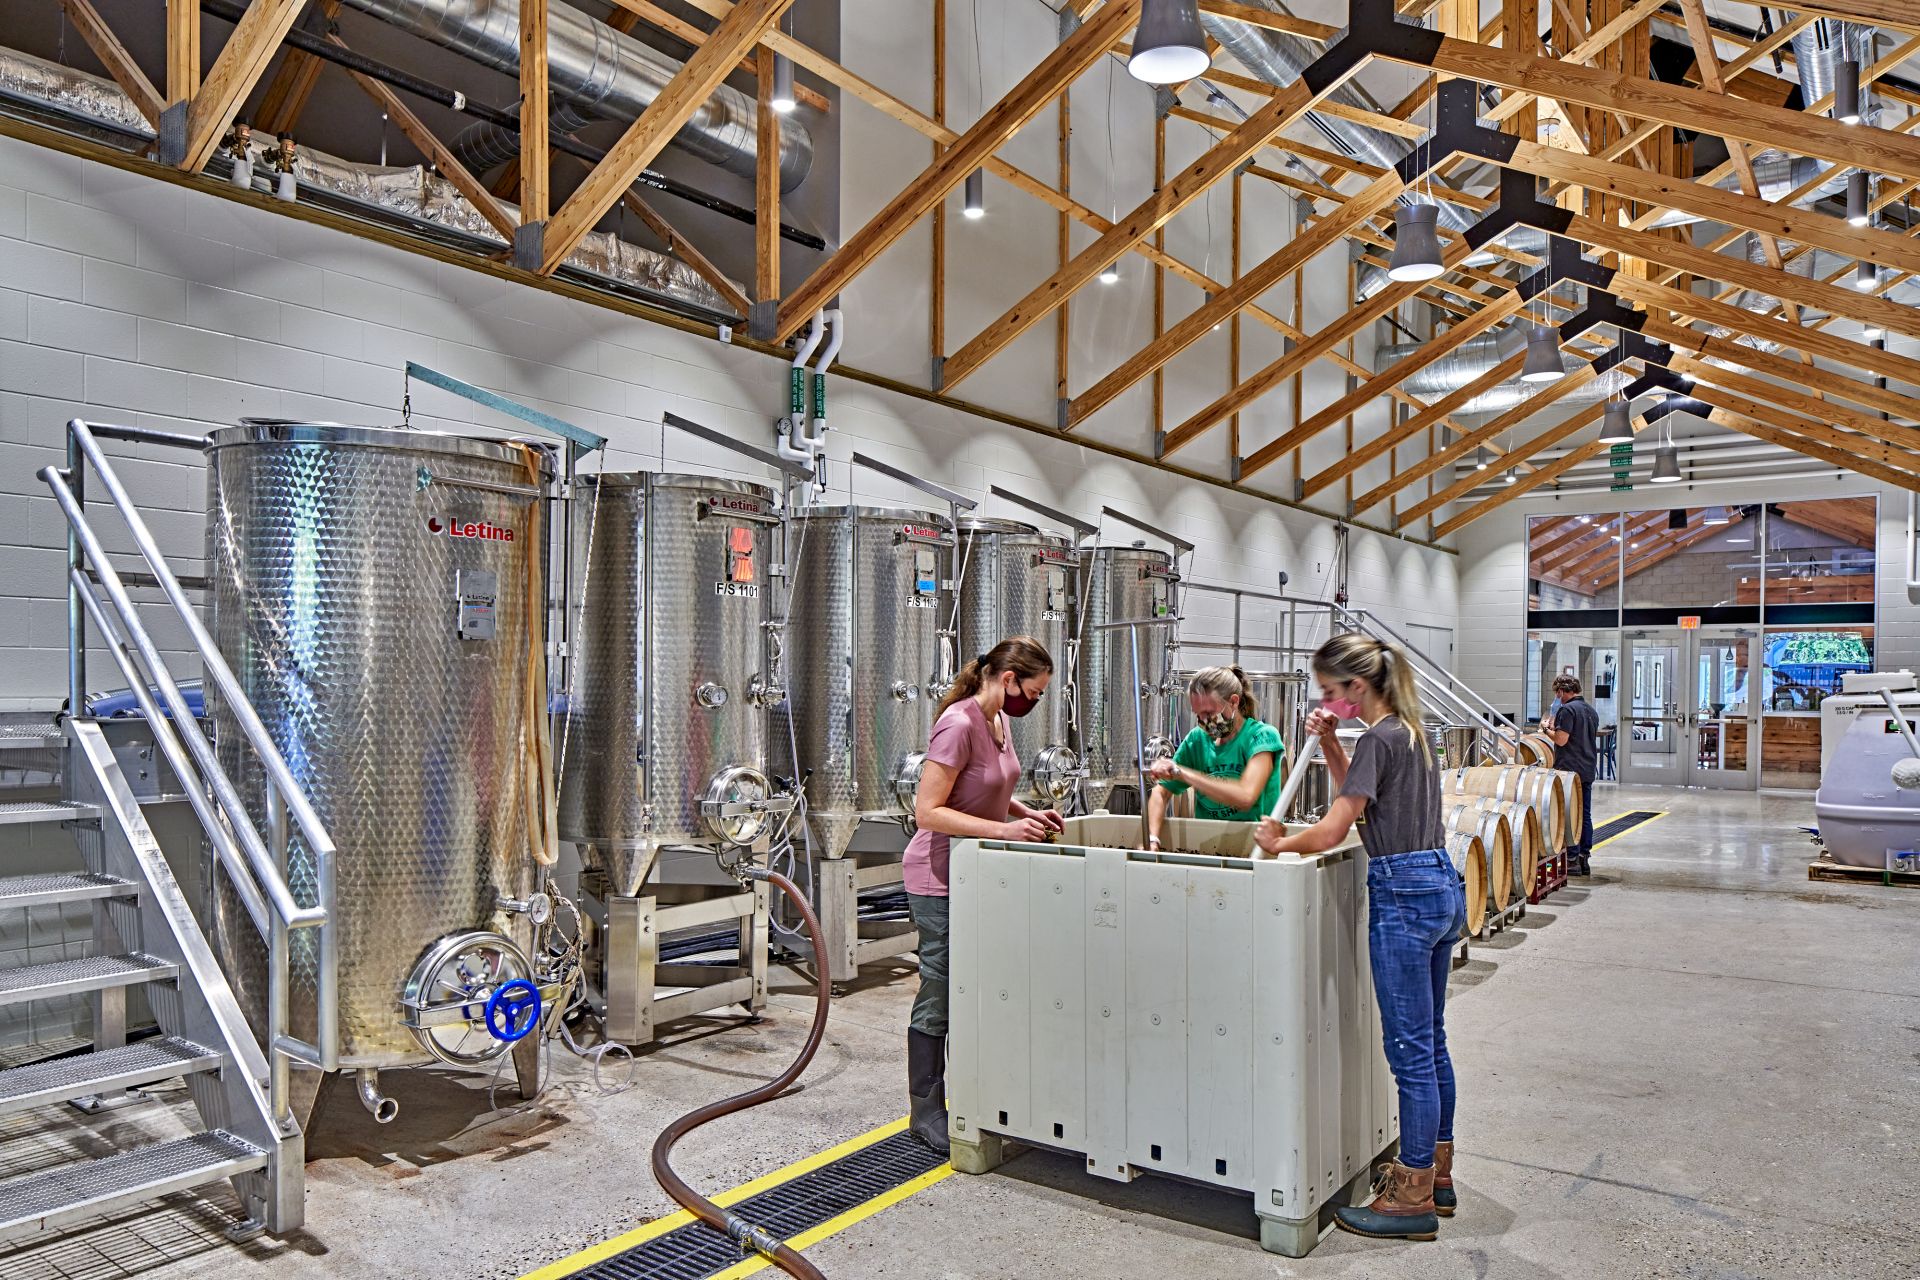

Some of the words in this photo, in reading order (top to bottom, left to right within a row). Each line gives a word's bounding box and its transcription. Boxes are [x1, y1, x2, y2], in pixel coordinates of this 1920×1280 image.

[723, 497, 759, 512] Letina
[450, 518, 514, 541] Letina
[716, 582, 735, 595] F/S
[739, 584, 758, 597] 1101
[906, 596, 921, 607] F/S
